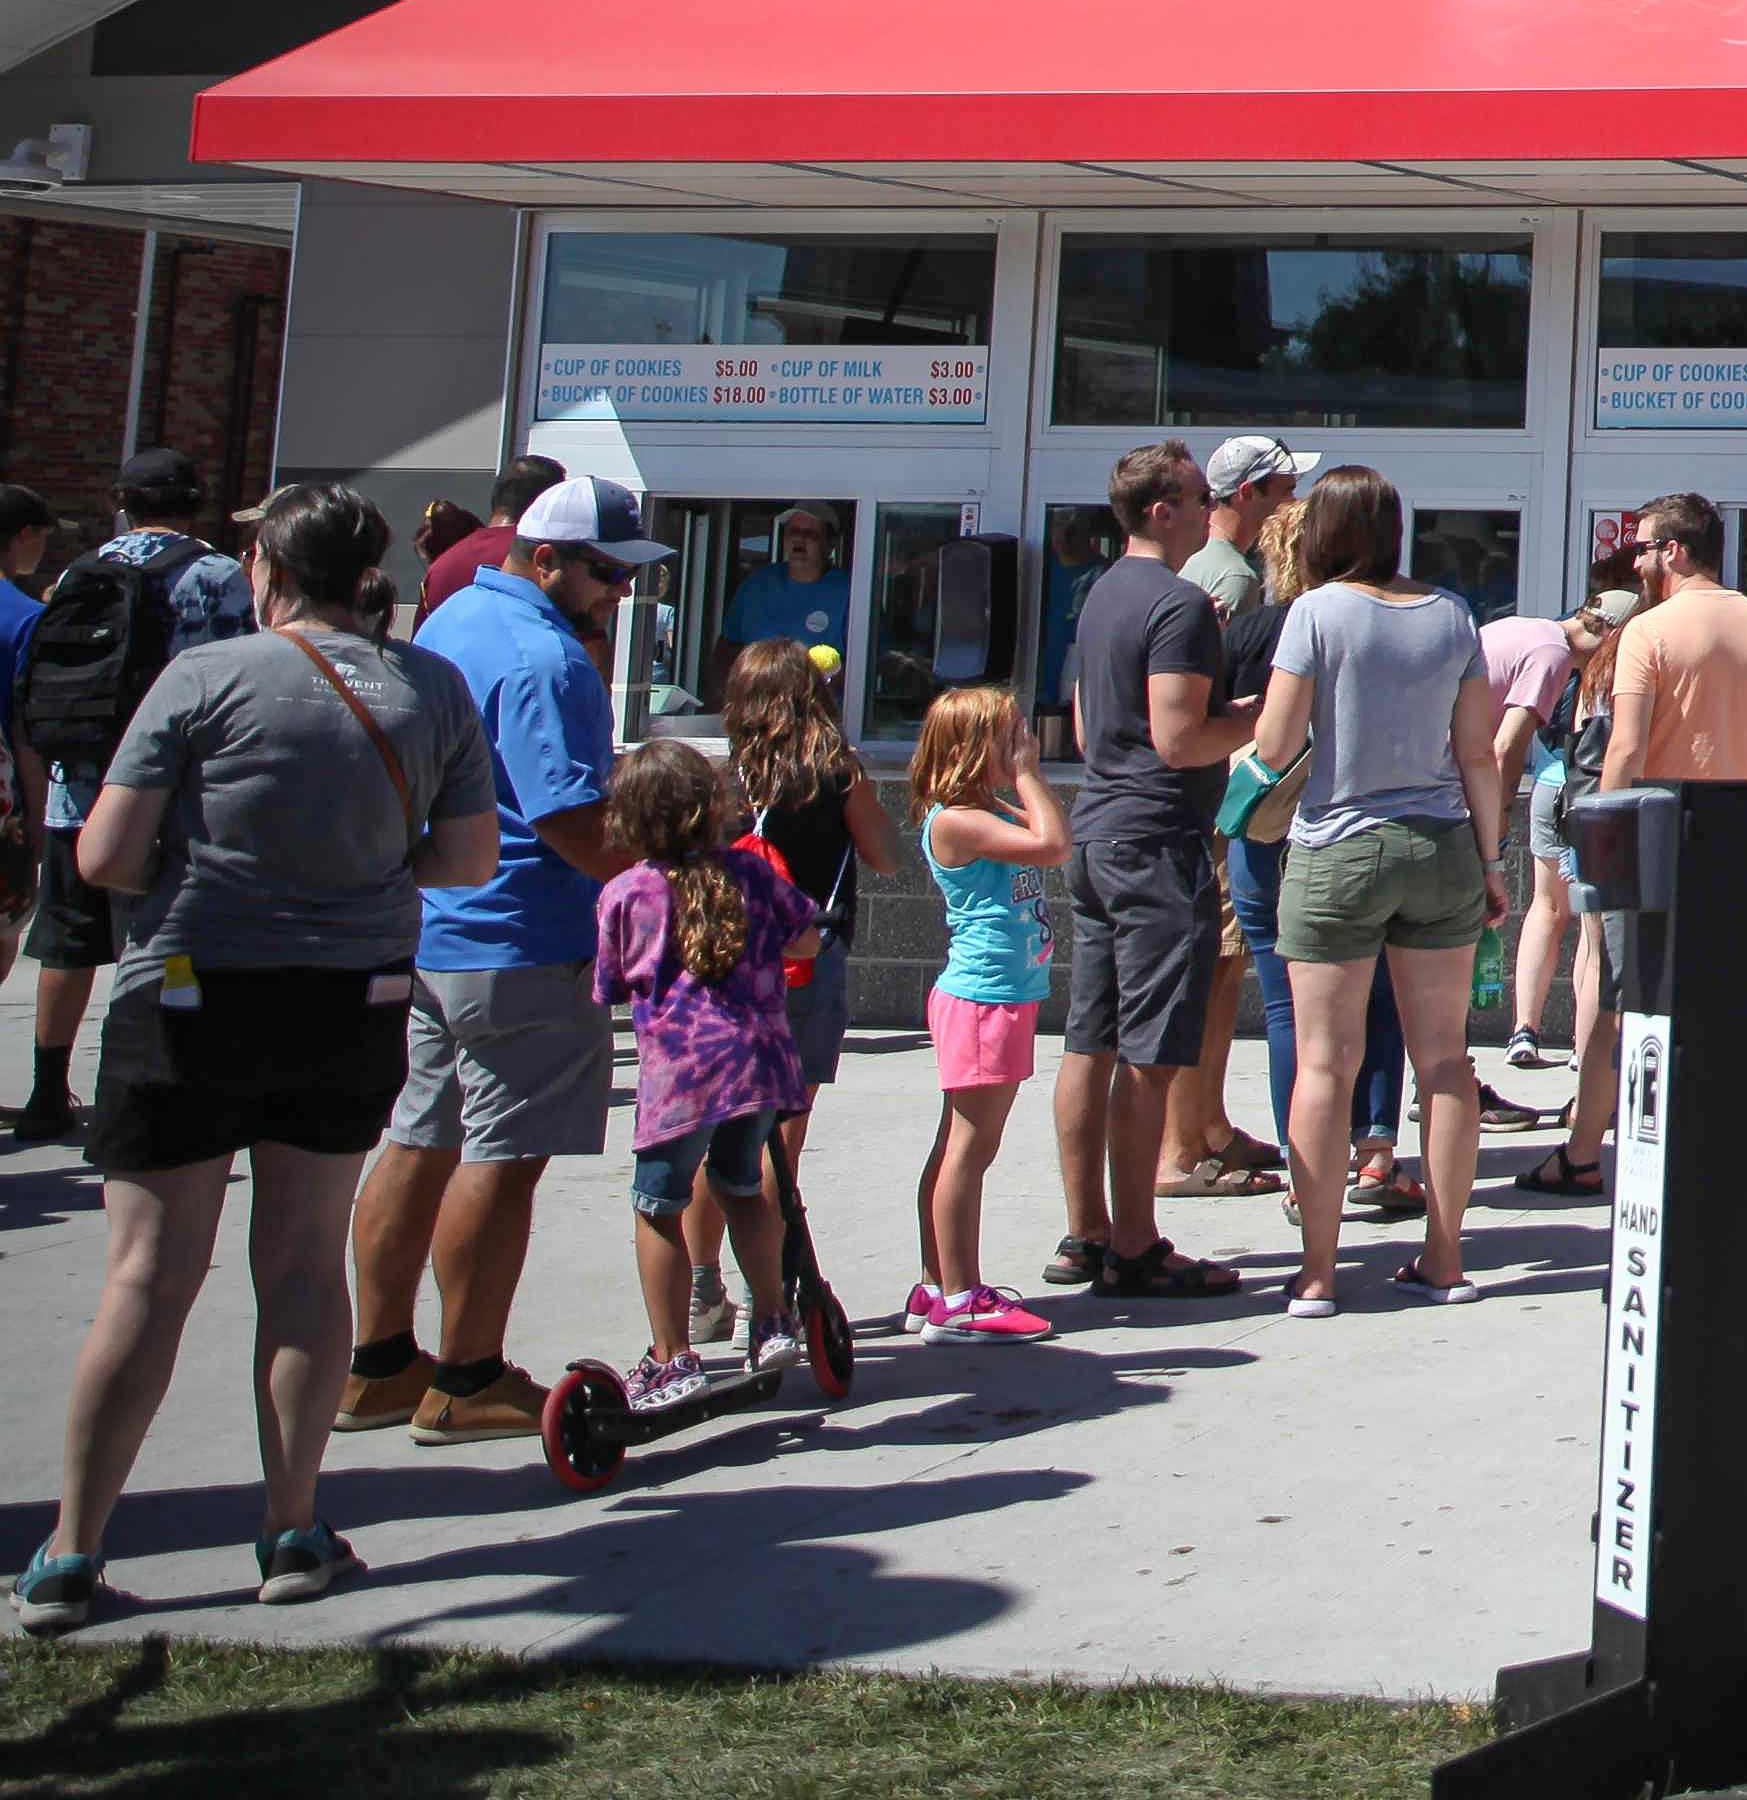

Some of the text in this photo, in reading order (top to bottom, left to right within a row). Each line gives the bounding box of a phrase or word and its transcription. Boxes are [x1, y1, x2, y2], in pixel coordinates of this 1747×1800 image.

[554, 360, 973, 379] CUP OF COOKIES $5.00 CUP OF MILK $3.00
[1612, 364, 1646, 382] CUP
[1652, 364, 1674, 381] OF
[552, 386, 972, 406] BUCKET OF COOKIES $18.00 BOTTLE OF WATER $3.00
[1611, 391, 1677, 409] BUCKET
[1682, 391, 1704, 409] OF
[311, 676, 385, 691] THVENT
[1619, 1200, 1659, 1237] HAND
[1611, 1246, 1648, 1592] SANITIZER
